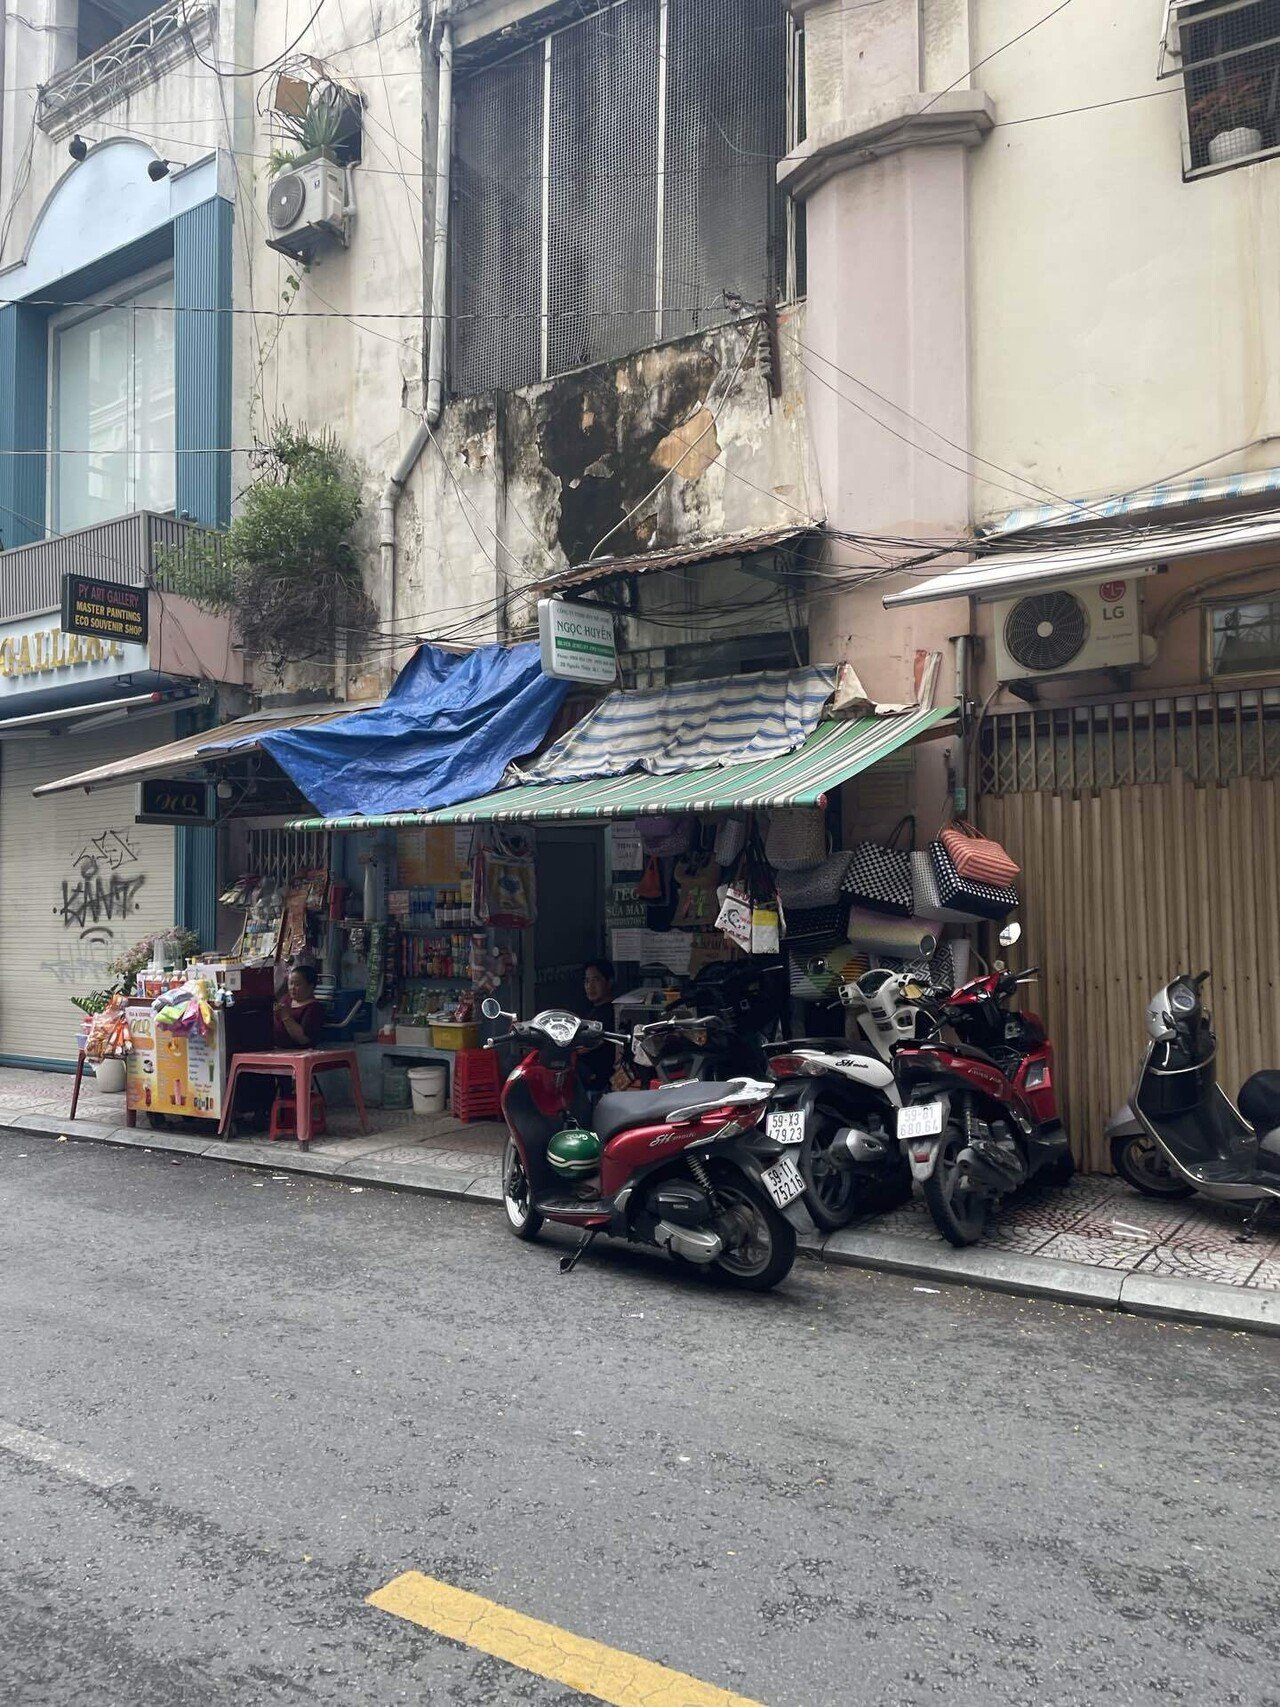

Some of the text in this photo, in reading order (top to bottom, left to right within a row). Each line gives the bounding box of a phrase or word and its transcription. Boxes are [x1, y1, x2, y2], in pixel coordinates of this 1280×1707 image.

[91, 587, 105, 601] ART
[107, 590, 139, 608] GALLERY
[76, 601, 142, 622] MASTER PAINTINGS
[1103, 606, 1125, 620] LG
[74, 615, 143, 636] ECO SOUVENIR SHOP
[773, 1113, 800, 1128] 59-X3
[900, 1118, 938, 1136] 680.64
[768, 1161, 793, 1187] 59-T1
[773, 1174, 804, 1206] 752.16
